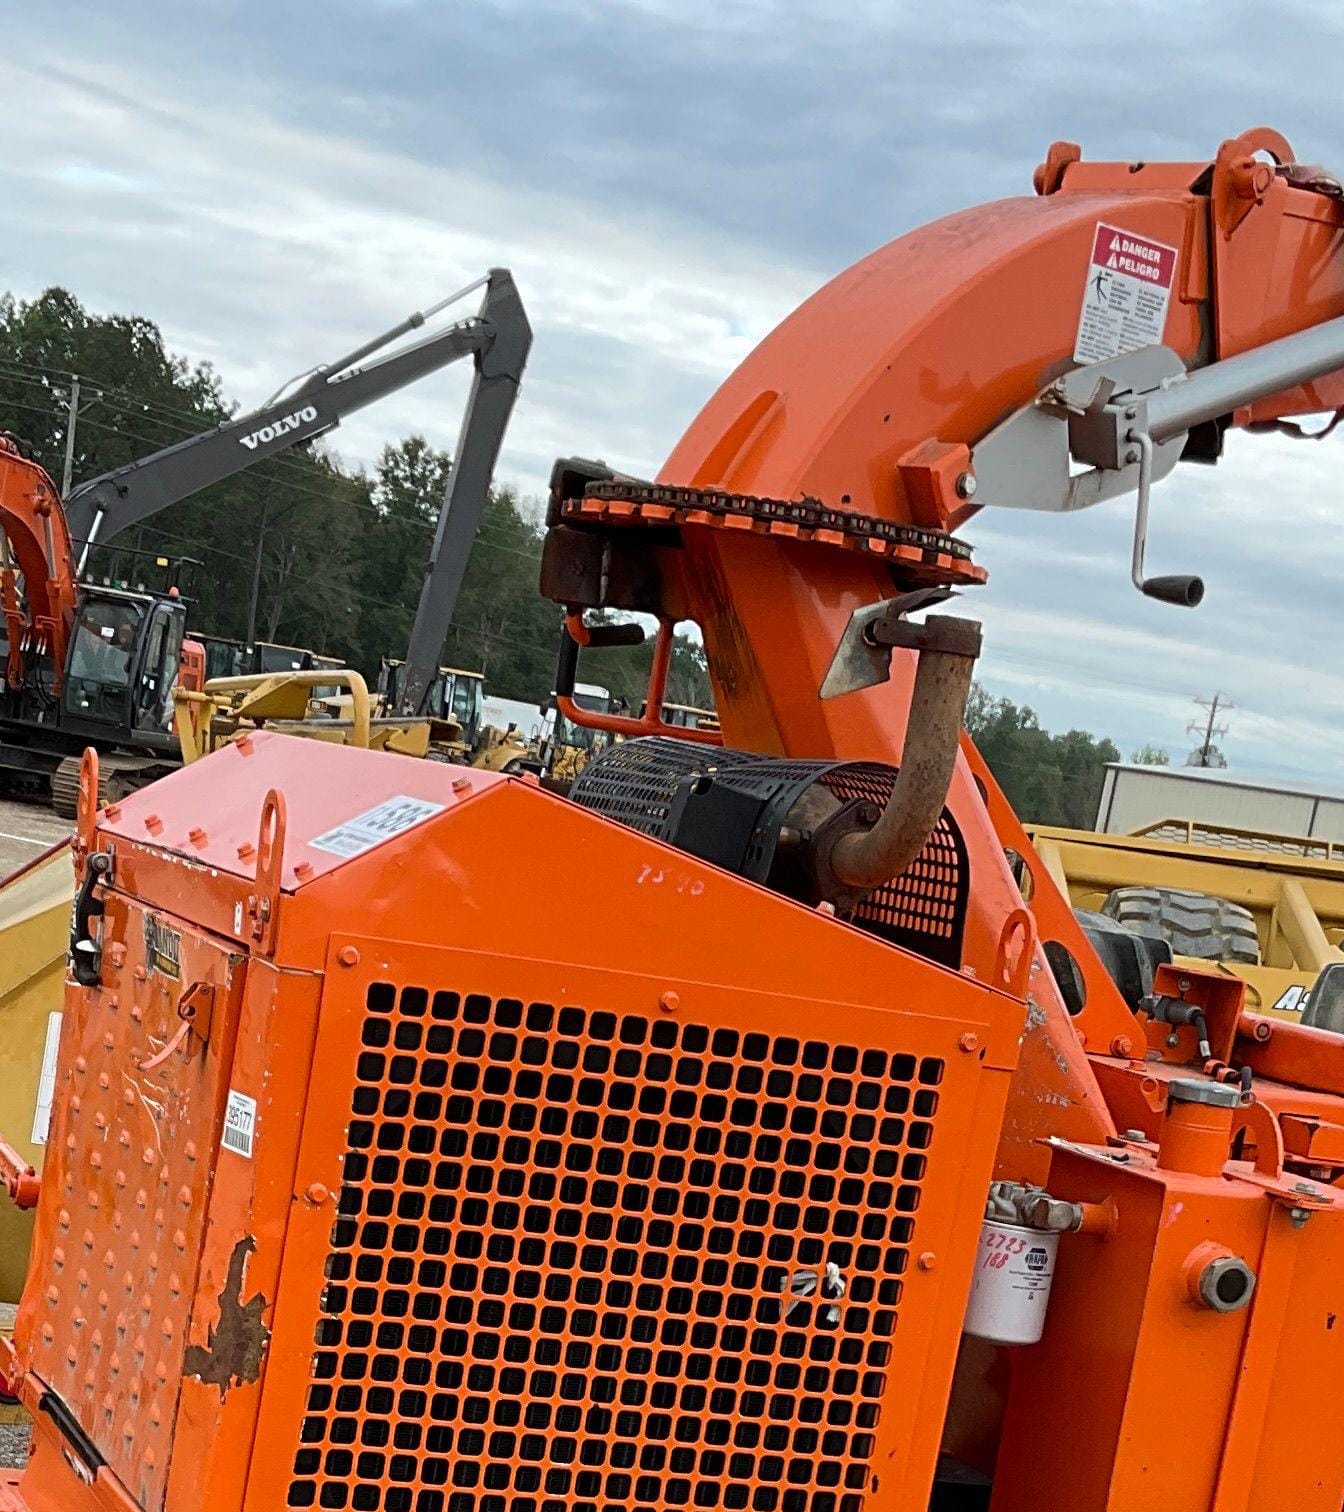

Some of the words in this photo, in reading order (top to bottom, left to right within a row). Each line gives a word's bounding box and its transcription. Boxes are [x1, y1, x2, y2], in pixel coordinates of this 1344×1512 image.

[1121, 239, 1161, 264] DANGER
[1118, 256, 1160, 280] PELIGRO
[239, 406, 318, 450] VOLVO
